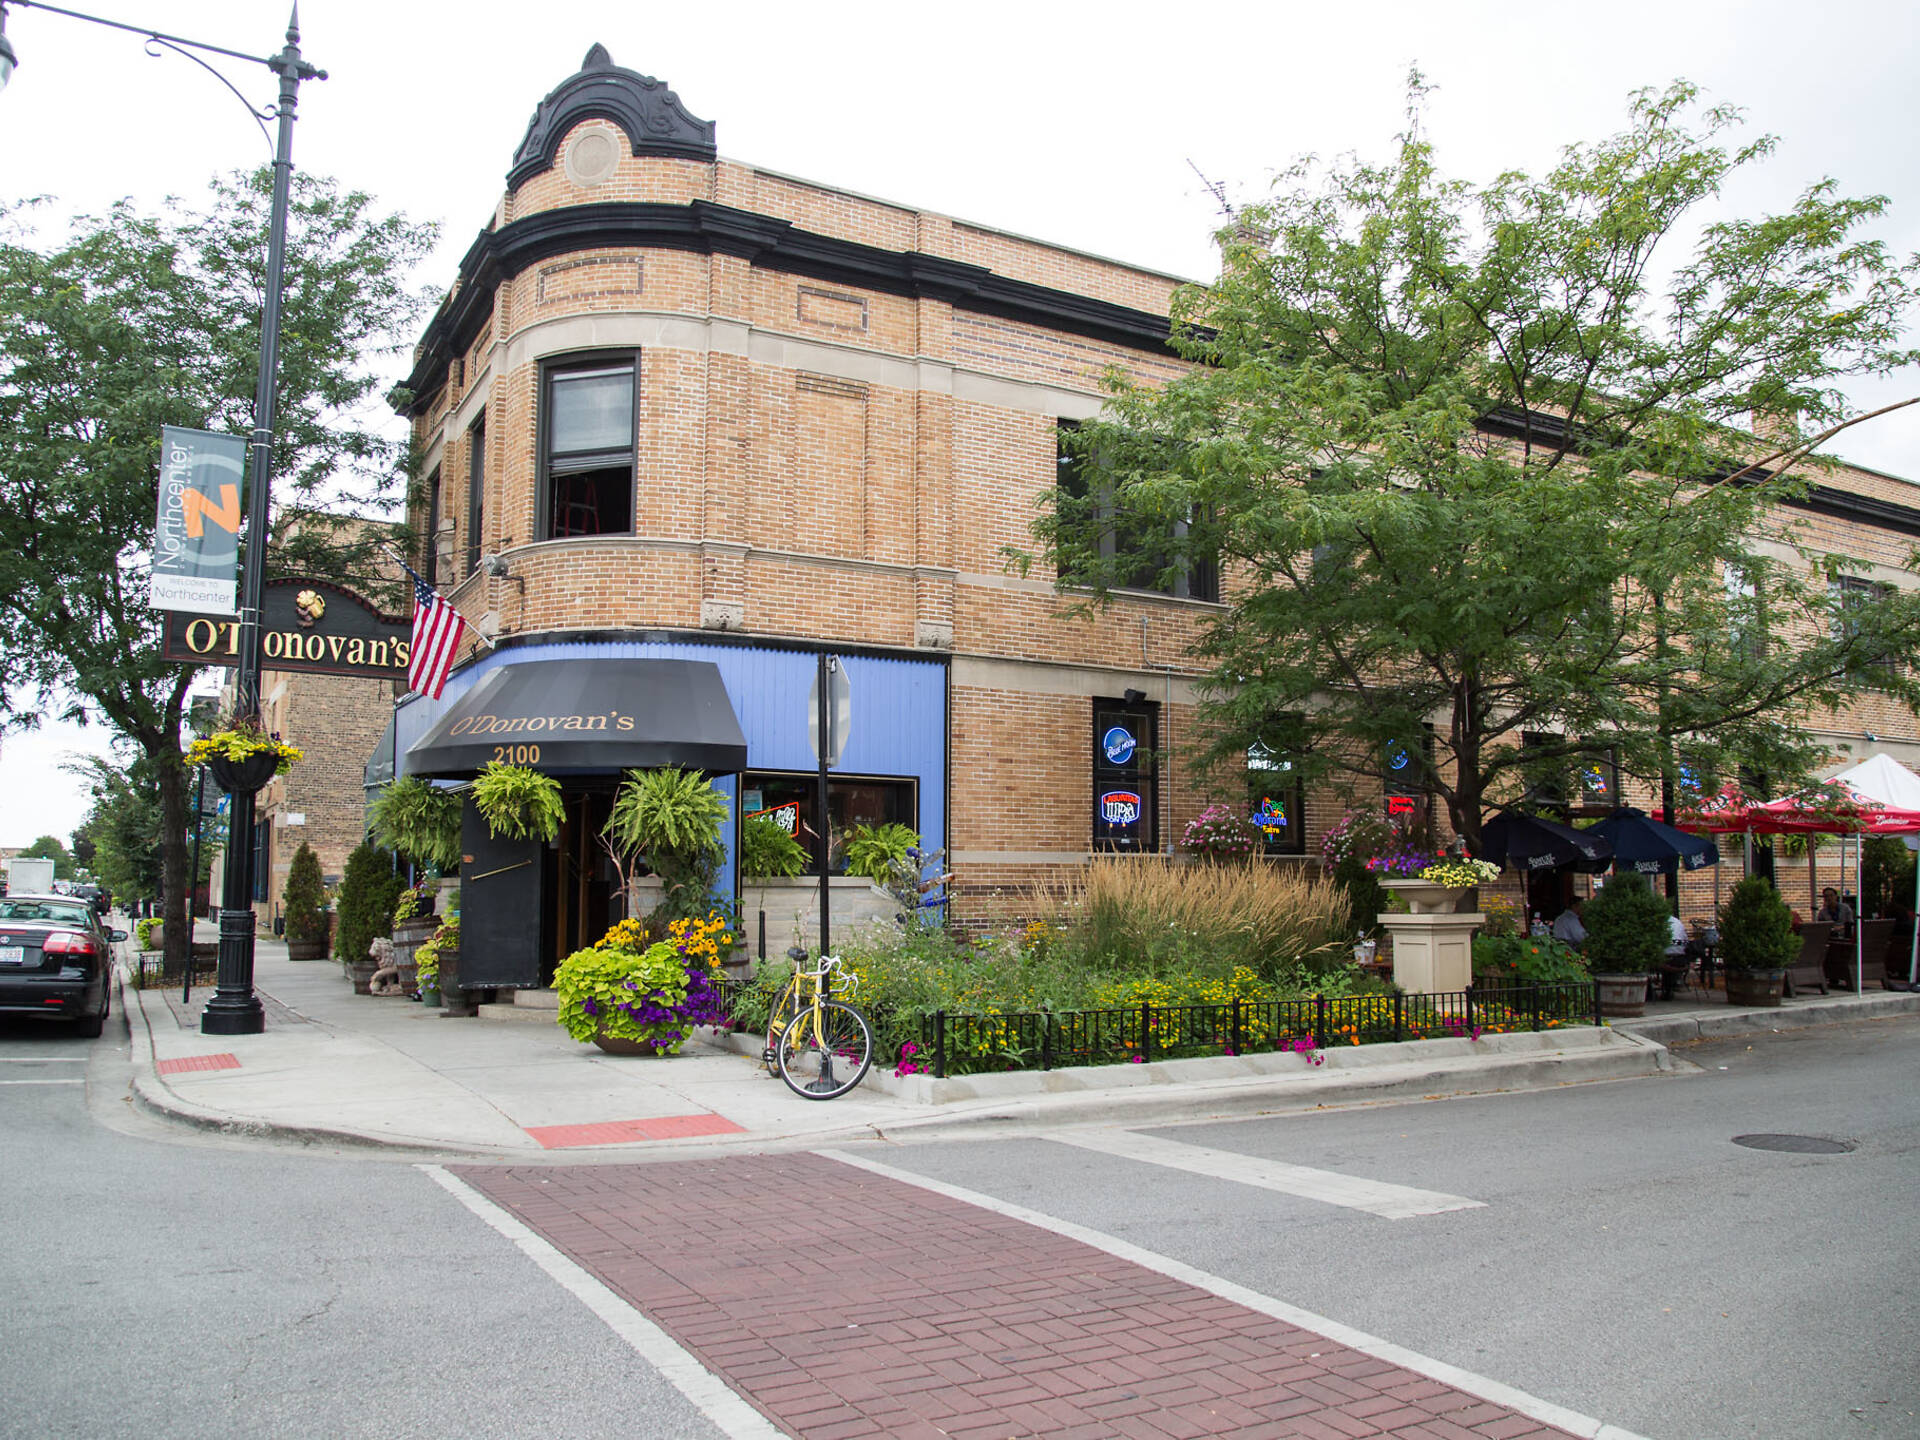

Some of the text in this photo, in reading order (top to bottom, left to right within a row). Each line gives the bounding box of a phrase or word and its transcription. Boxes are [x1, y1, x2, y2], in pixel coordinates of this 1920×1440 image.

[157, 441, 188, 569] Northcenter
[155, 586, 231, 603] Northcenter
[450, 711, 635, 736] O'Donovan's
[493, 744, 541, 764] 2100
[1252, 812, 1288, 828] Corona
[1874, 814, 1911, 826] Budweiser
[1262, 824, 1280, 834] Extra
